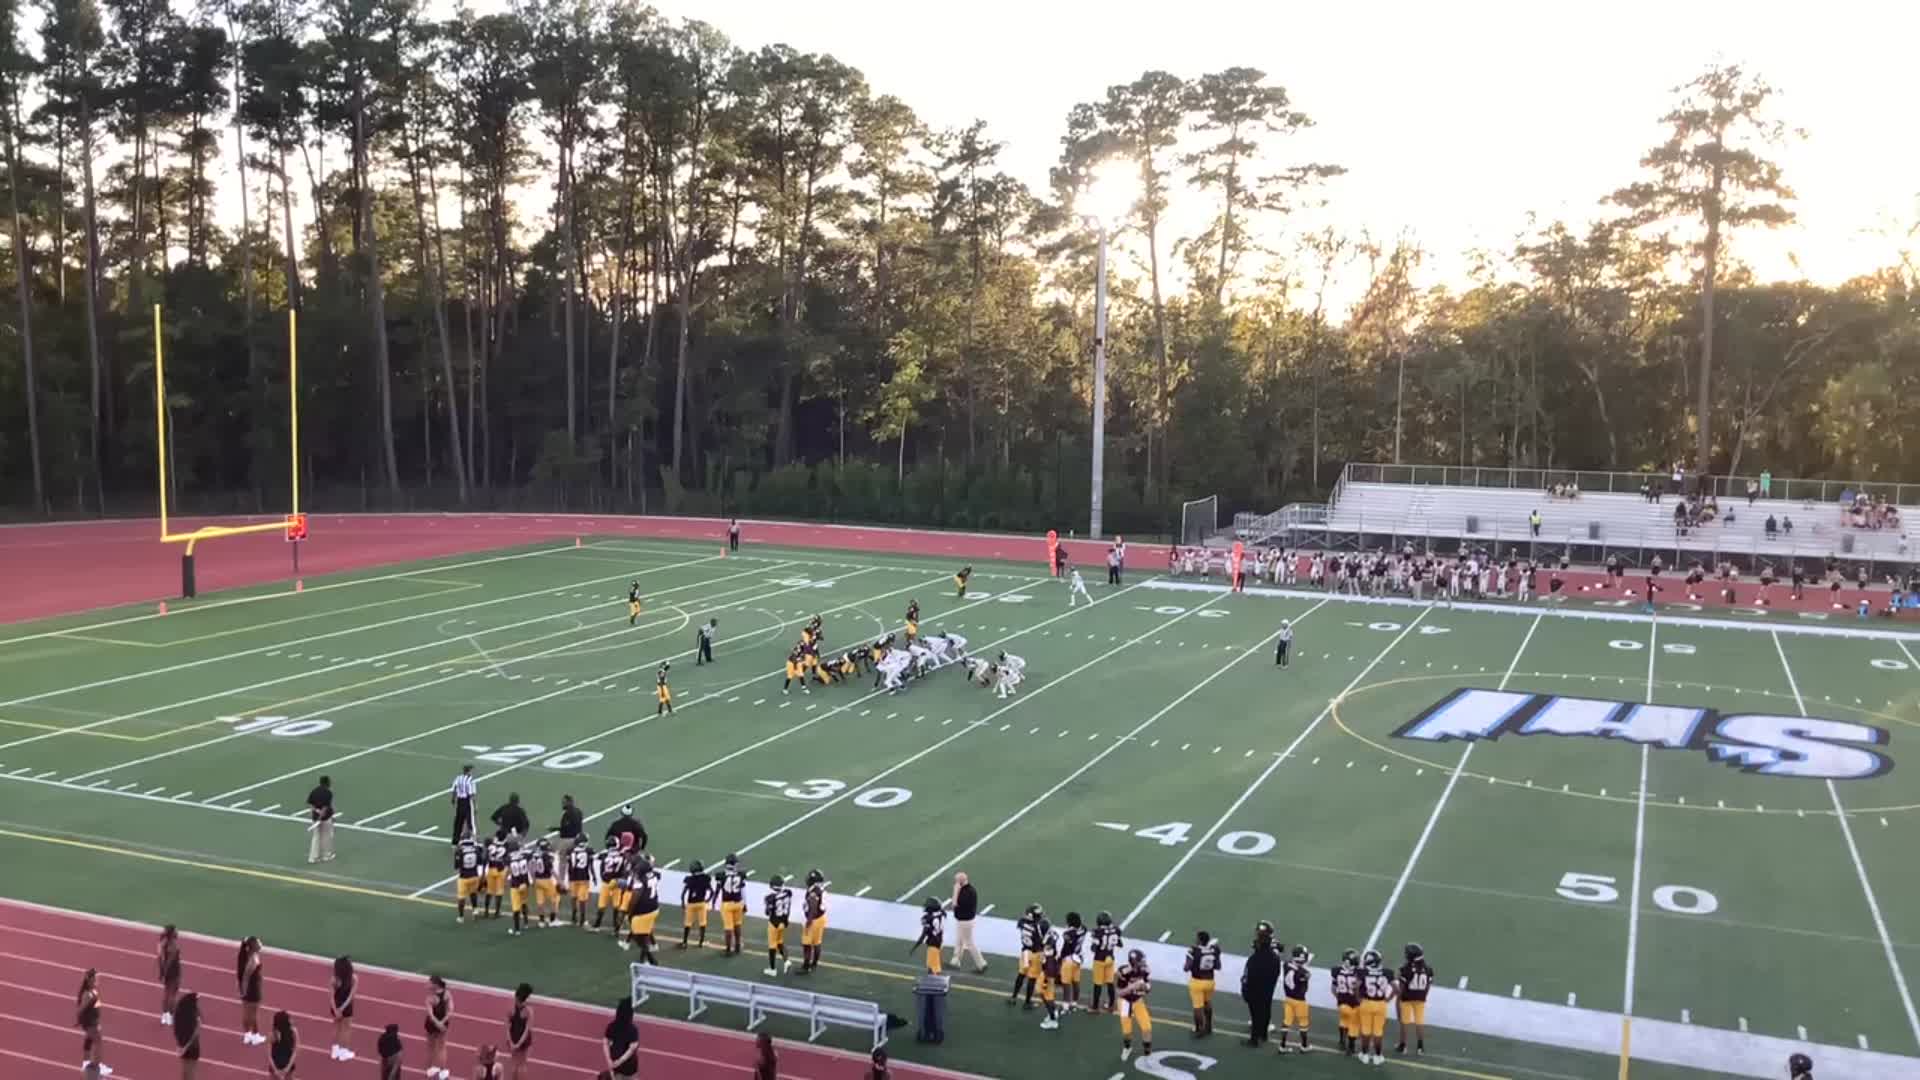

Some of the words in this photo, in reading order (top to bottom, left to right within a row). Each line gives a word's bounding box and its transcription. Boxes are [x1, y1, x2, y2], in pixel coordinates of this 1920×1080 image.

[1389, 687, 1895, 780] IHS
[484, 743, 603, 769] 20
[783, 778, 913, 808] 30
[1134, 821, 1277, 856] 40
[1555, 872, 1719, 914] 50
